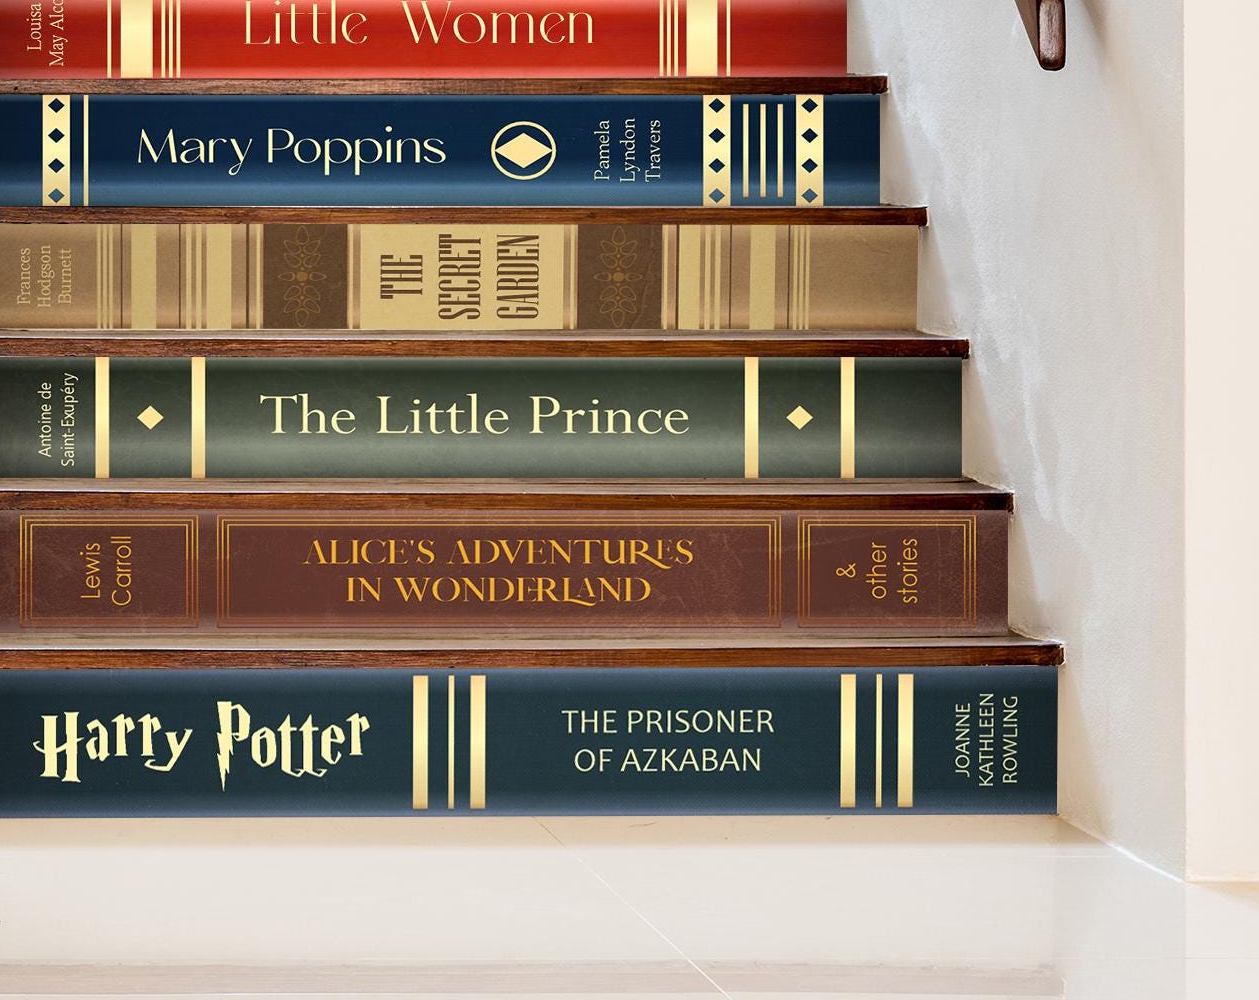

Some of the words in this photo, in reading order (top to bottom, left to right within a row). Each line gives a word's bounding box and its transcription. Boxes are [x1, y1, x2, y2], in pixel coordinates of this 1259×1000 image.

[26, 1, 43, 52] Louisa
[49, 34, 68, 67] May
[401, 0, 594, 45] Women
[137, 128, 252, 175] Mary
[267, 125, 447, 176] Poppins
[593, 119, 611, 182] Pamela
[620, 117, 639, 182] Lyndon
[644, 118, 662, 183] Travers
[16, 246, 32, 306] Frances
[37, 245, 56, 307] Hodgson
[57, 247, 73, 305] Burnett
[380, 254, 424, 300] THE
[438, 233, 482, 319] SECRET
[496, 234, 540, 319] GARDEN
[37, 381, 53, 401] de
[61, 372, 78, 466] Saint-Exupéry
[259, 393, 356, 434] The
[376, 393, 510, 434] Little
[529, 396, 690, 435] Prince
[37, 403, 53, 459] Antoine
[80, 542, 100, 598] Lewis
[111, 536, 131, 606] Carroll
[302, 539, 436, 566] ALICE'S
[446, 539, 695, 569] ADVENTURES
[835, 562, 857, 579] &
[865, 542, 887, 599] other
[897, 538, 918, 604] stories
[345, 577, 382, 602] IN
[393, 577, 652, 606] WONDERLAND
[33, 711, 193, 783] Harry
[216, 701, 370, 792] Potter
[561, 709, 618, 733] THE
[628, 709, 774, 734] PRISONER
[954, 702, 971, 778] JOANNE
[978, 692, 995, 788] KATHLEEN
[1002, 695, 1018, 785] ROWLING
[573, 748, 612, 772] OF
[620, 748, 761, 772] AZKABAN
